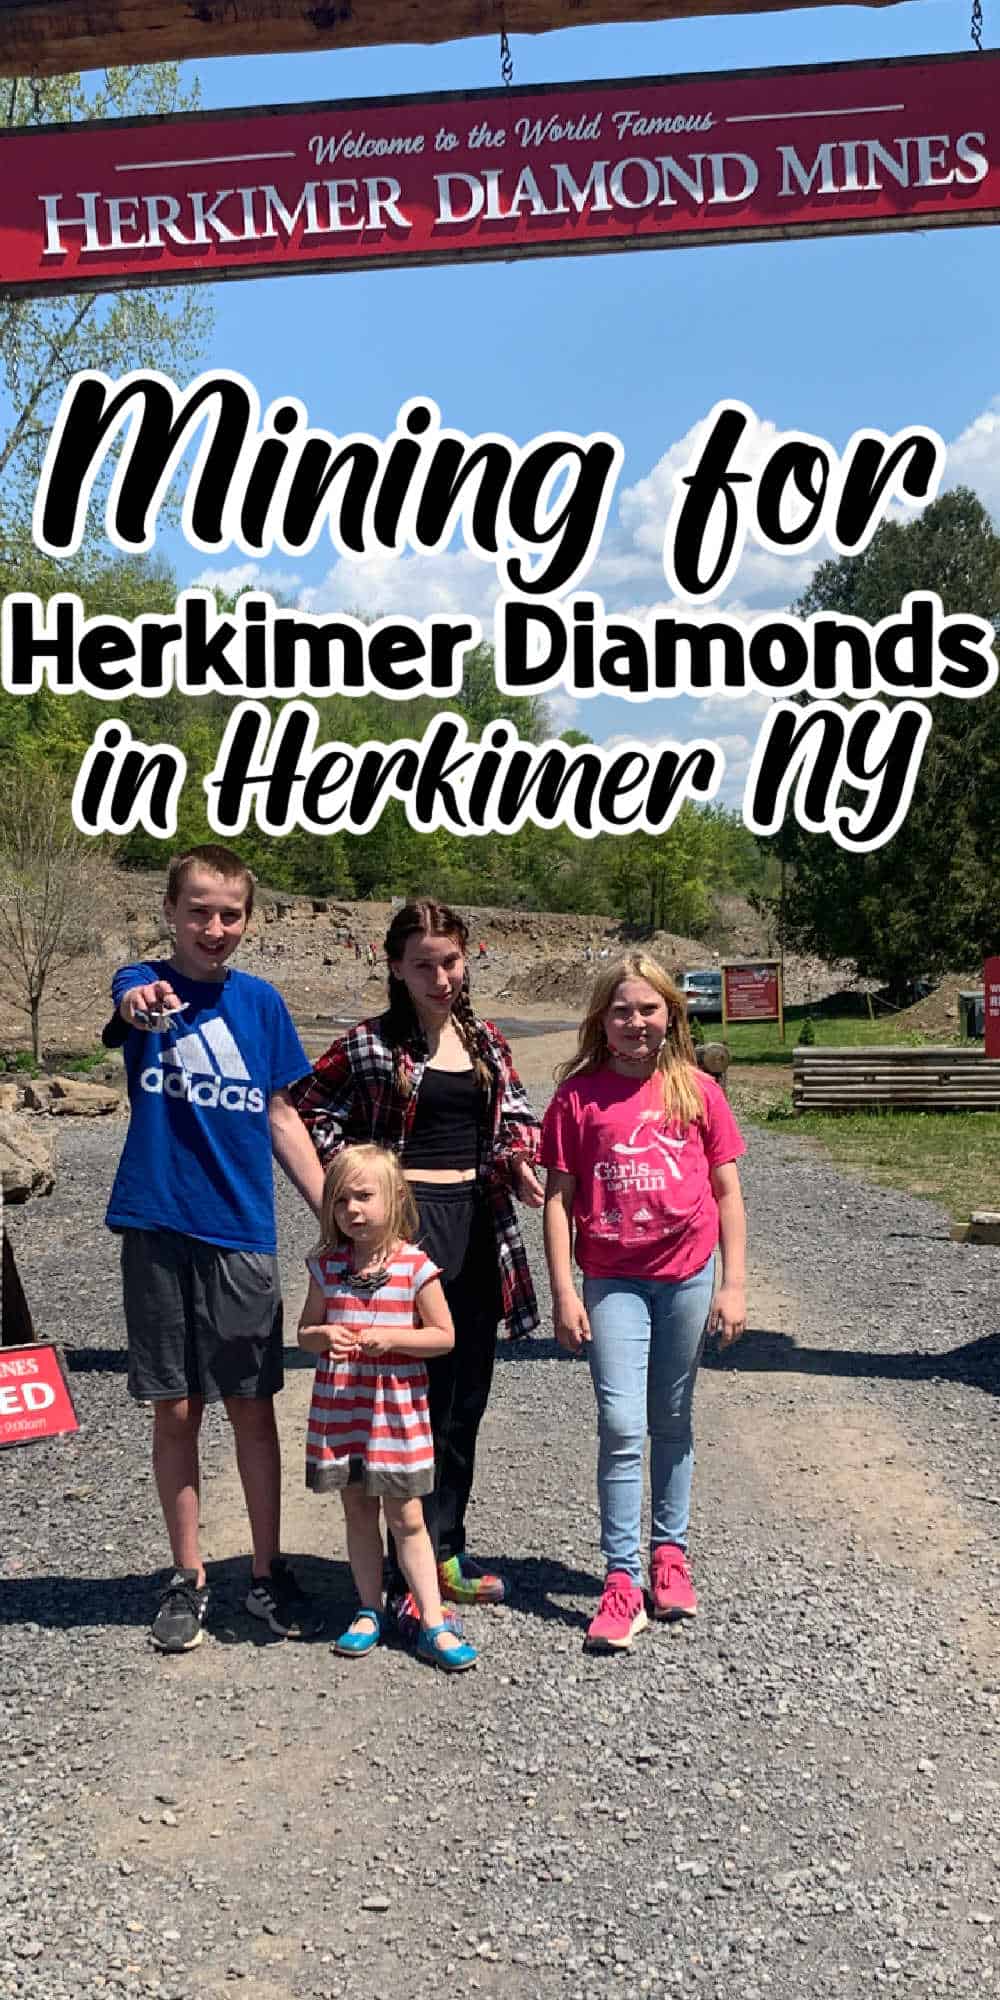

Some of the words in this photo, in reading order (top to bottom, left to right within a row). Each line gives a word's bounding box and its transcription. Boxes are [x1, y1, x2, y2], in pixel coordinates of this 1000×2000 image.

[308, 131, 425, 165] Welcome
[434, 128, 459, 151] to
[467, 122, 506, 148] the
[514, 113, 603, 147] World
[611, 111, 715, 140] Famous
[38, 175, 414, 256] HERKIMER
[433, 150, 758, 225] DIAMOND
[777, 131, 989, 197] MINES
[140, 1066, 264, 1113] adidas
[594, 1159, 649, 1180] Girls
[621, 1175, 665, 1193] run
[0, 1381, 56, 1415] ED
